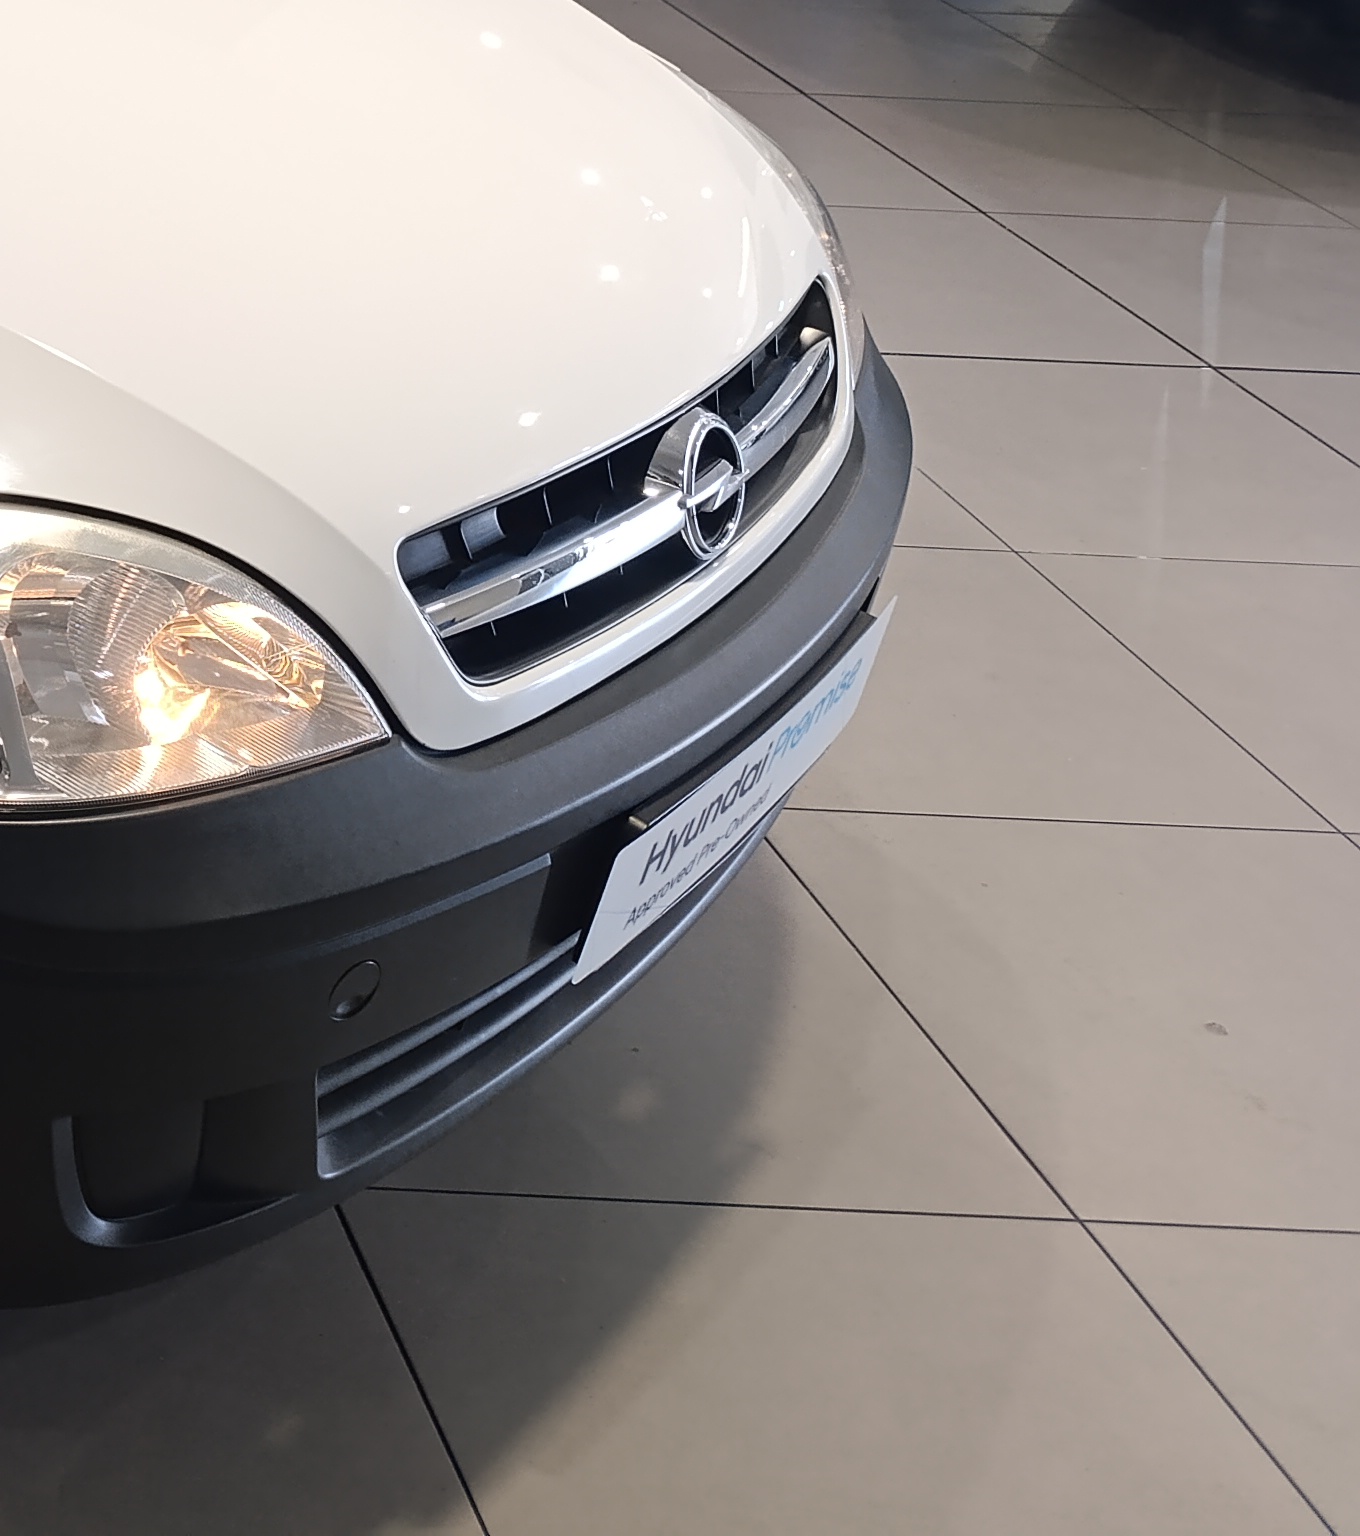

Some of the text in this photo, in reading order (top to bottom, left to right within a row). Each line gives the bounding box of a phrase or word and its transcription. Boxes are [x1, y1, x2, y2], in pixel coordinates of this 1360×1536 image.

[622, 781, 773, 931] Approved Pre-Owned
[638, 740, 774, 887] Hyundai
